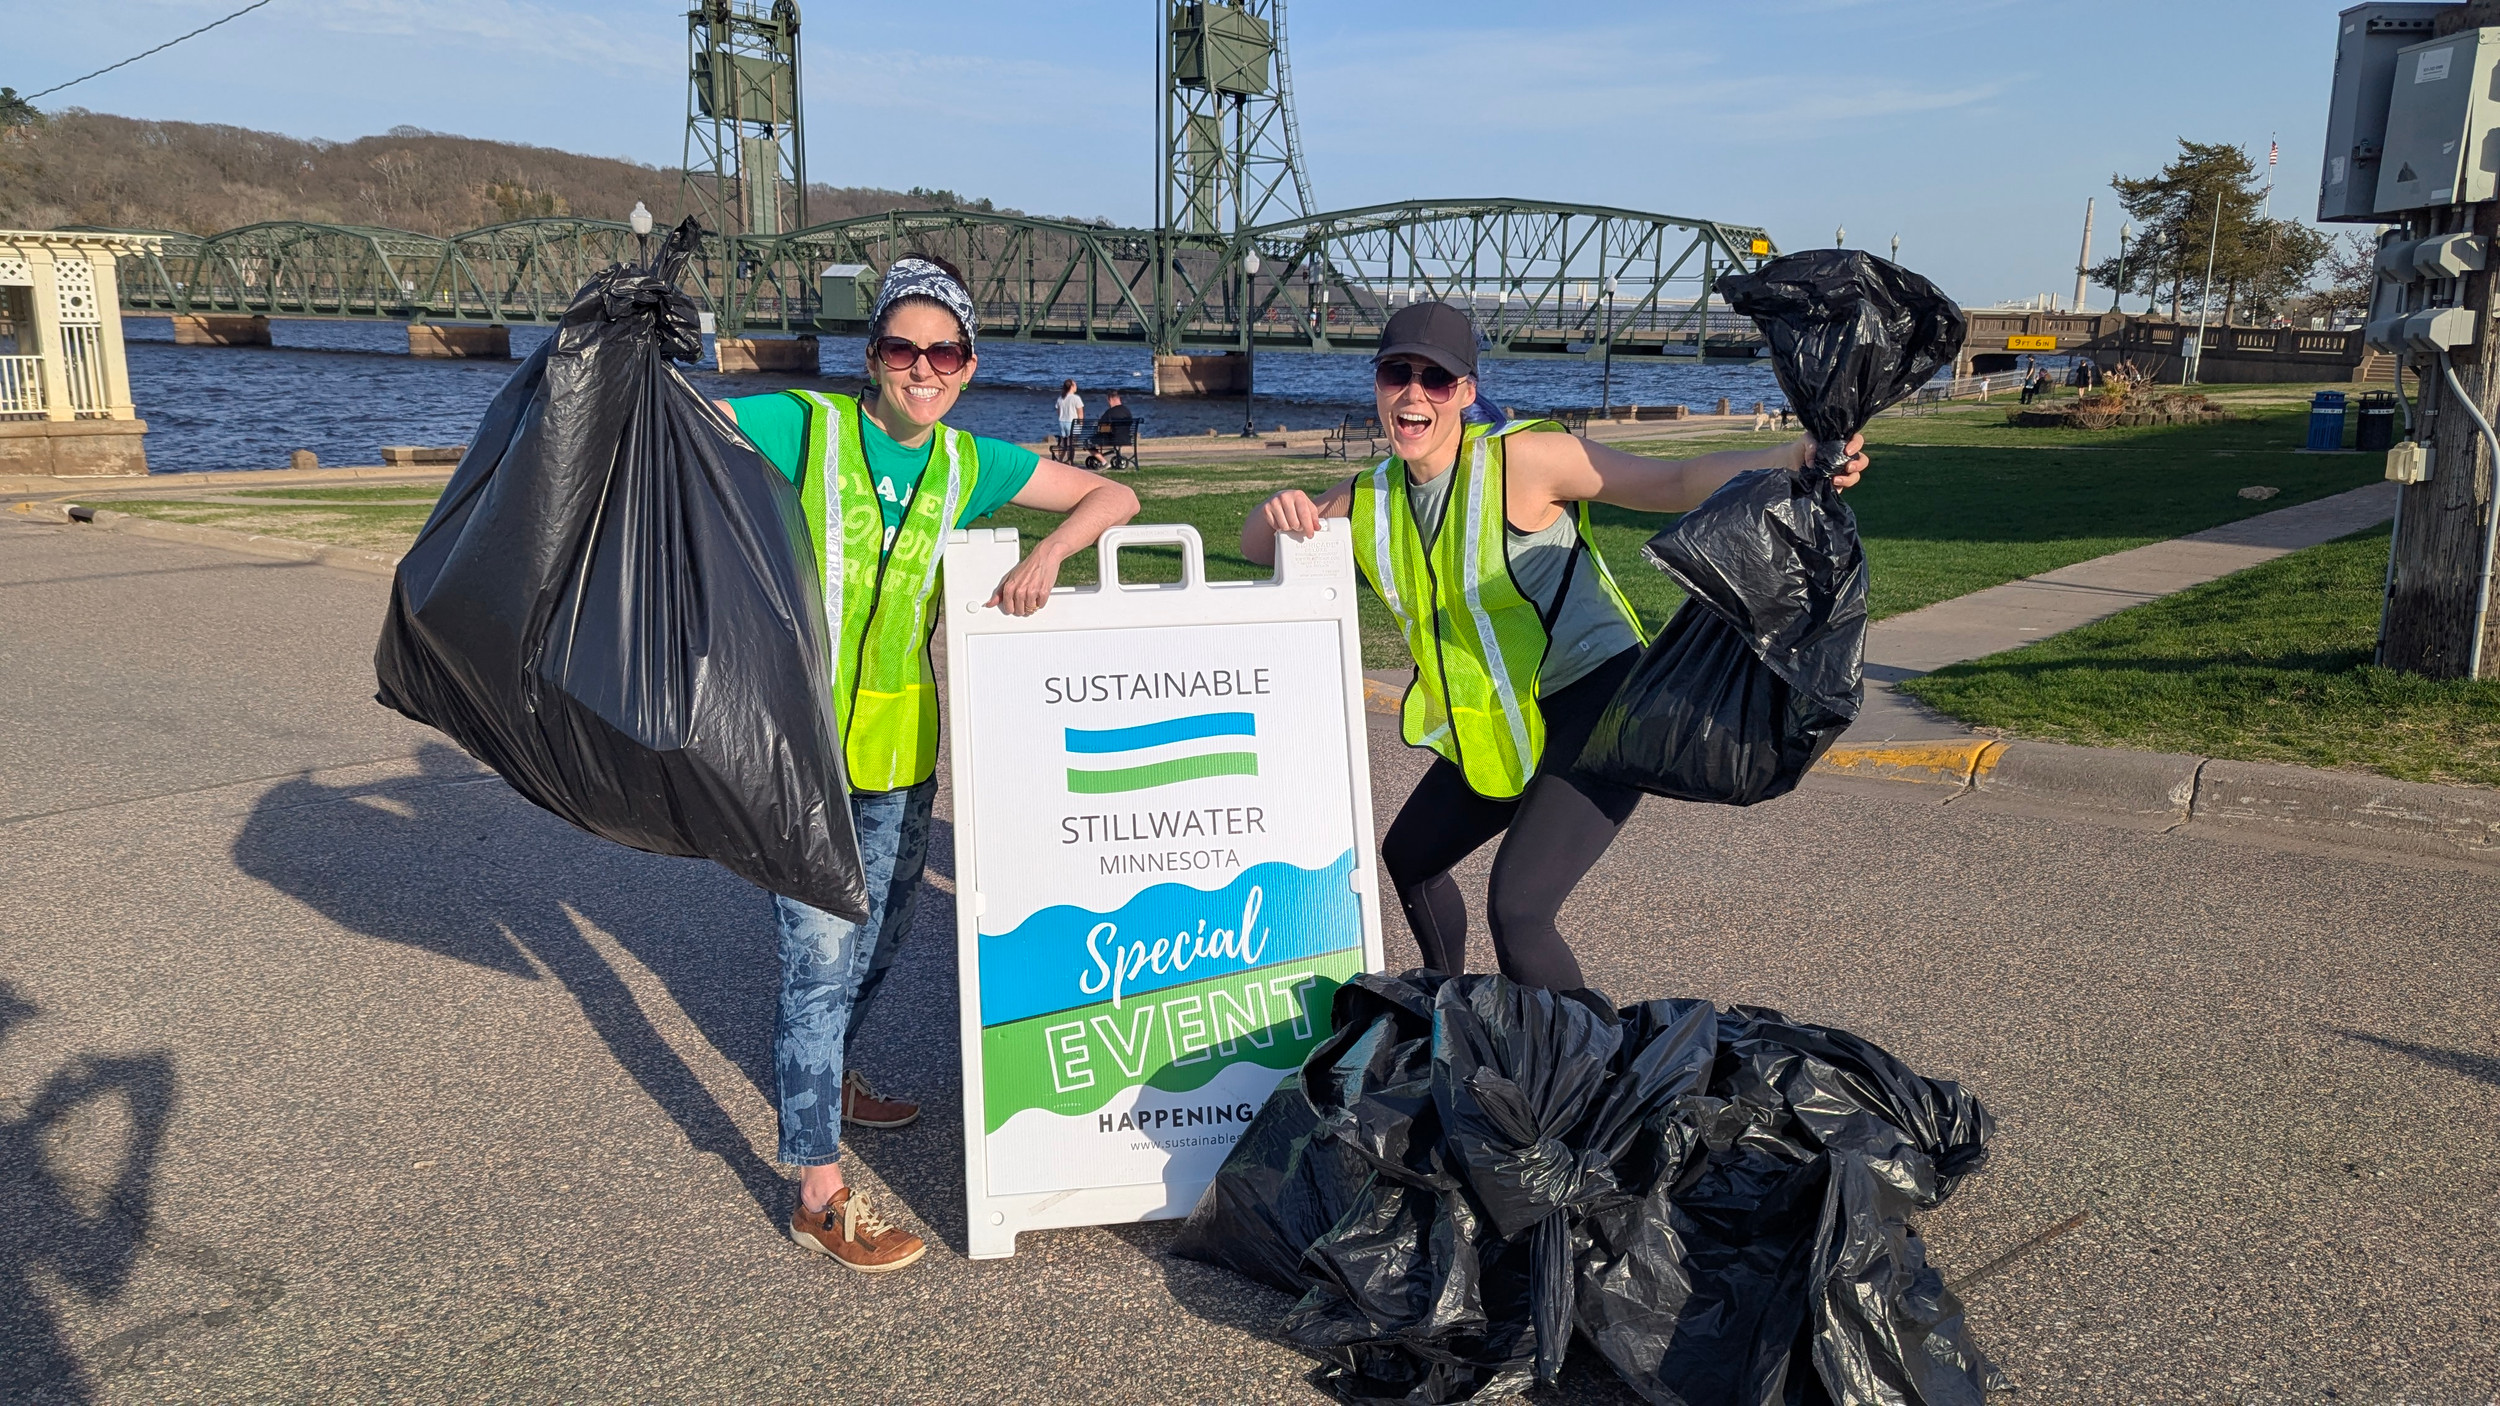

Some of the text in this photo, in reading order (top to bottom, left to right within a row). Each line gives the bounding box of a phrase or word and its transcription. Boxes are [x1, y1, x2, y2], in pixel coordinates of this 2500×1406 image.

[1044, 668, 1271, 704] SUSTAINABLE
[1061, 806, 1266, 845] STILLWATER
[1100, 848, 1240, 875] MINNESOTA
[1078, 884, 1269, 1010] Special
[1044, 971, 1316, 1094] EVENT
[1098, 1102, 1253, 1133] HAPPENING
